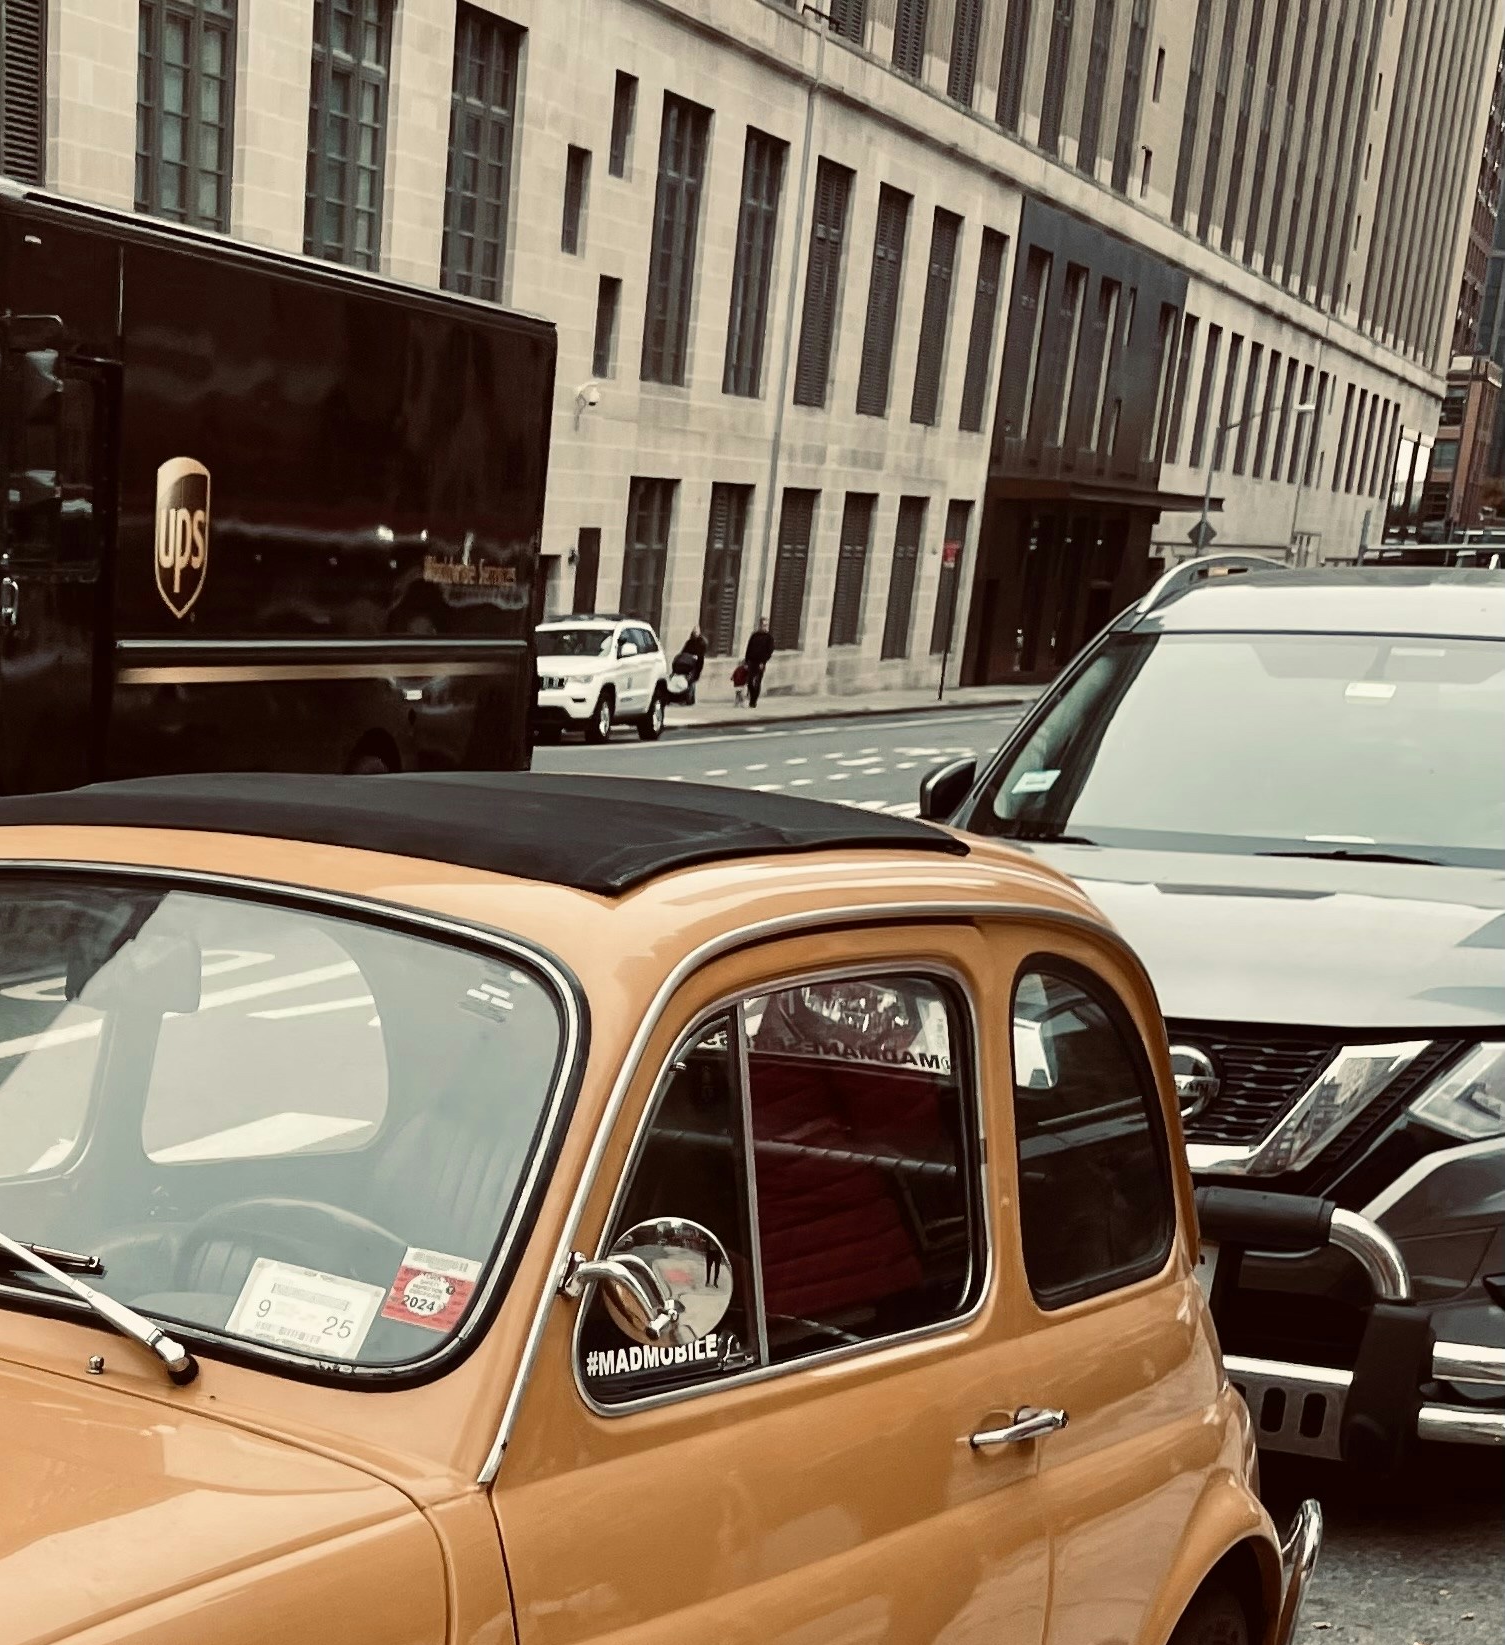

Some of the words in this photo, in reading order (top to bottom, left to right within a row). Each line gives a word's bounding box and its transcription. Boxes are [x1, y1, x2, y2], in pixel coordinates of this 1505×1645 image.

[159, 507, 205, 593] ups
[256, 1299, 271, 1318] 9
[322, 1316, 354, 1339] 25
[402, 1294, 435, 1312] 2024
[586, 1333, 718, 1377] #MADMOBILE
